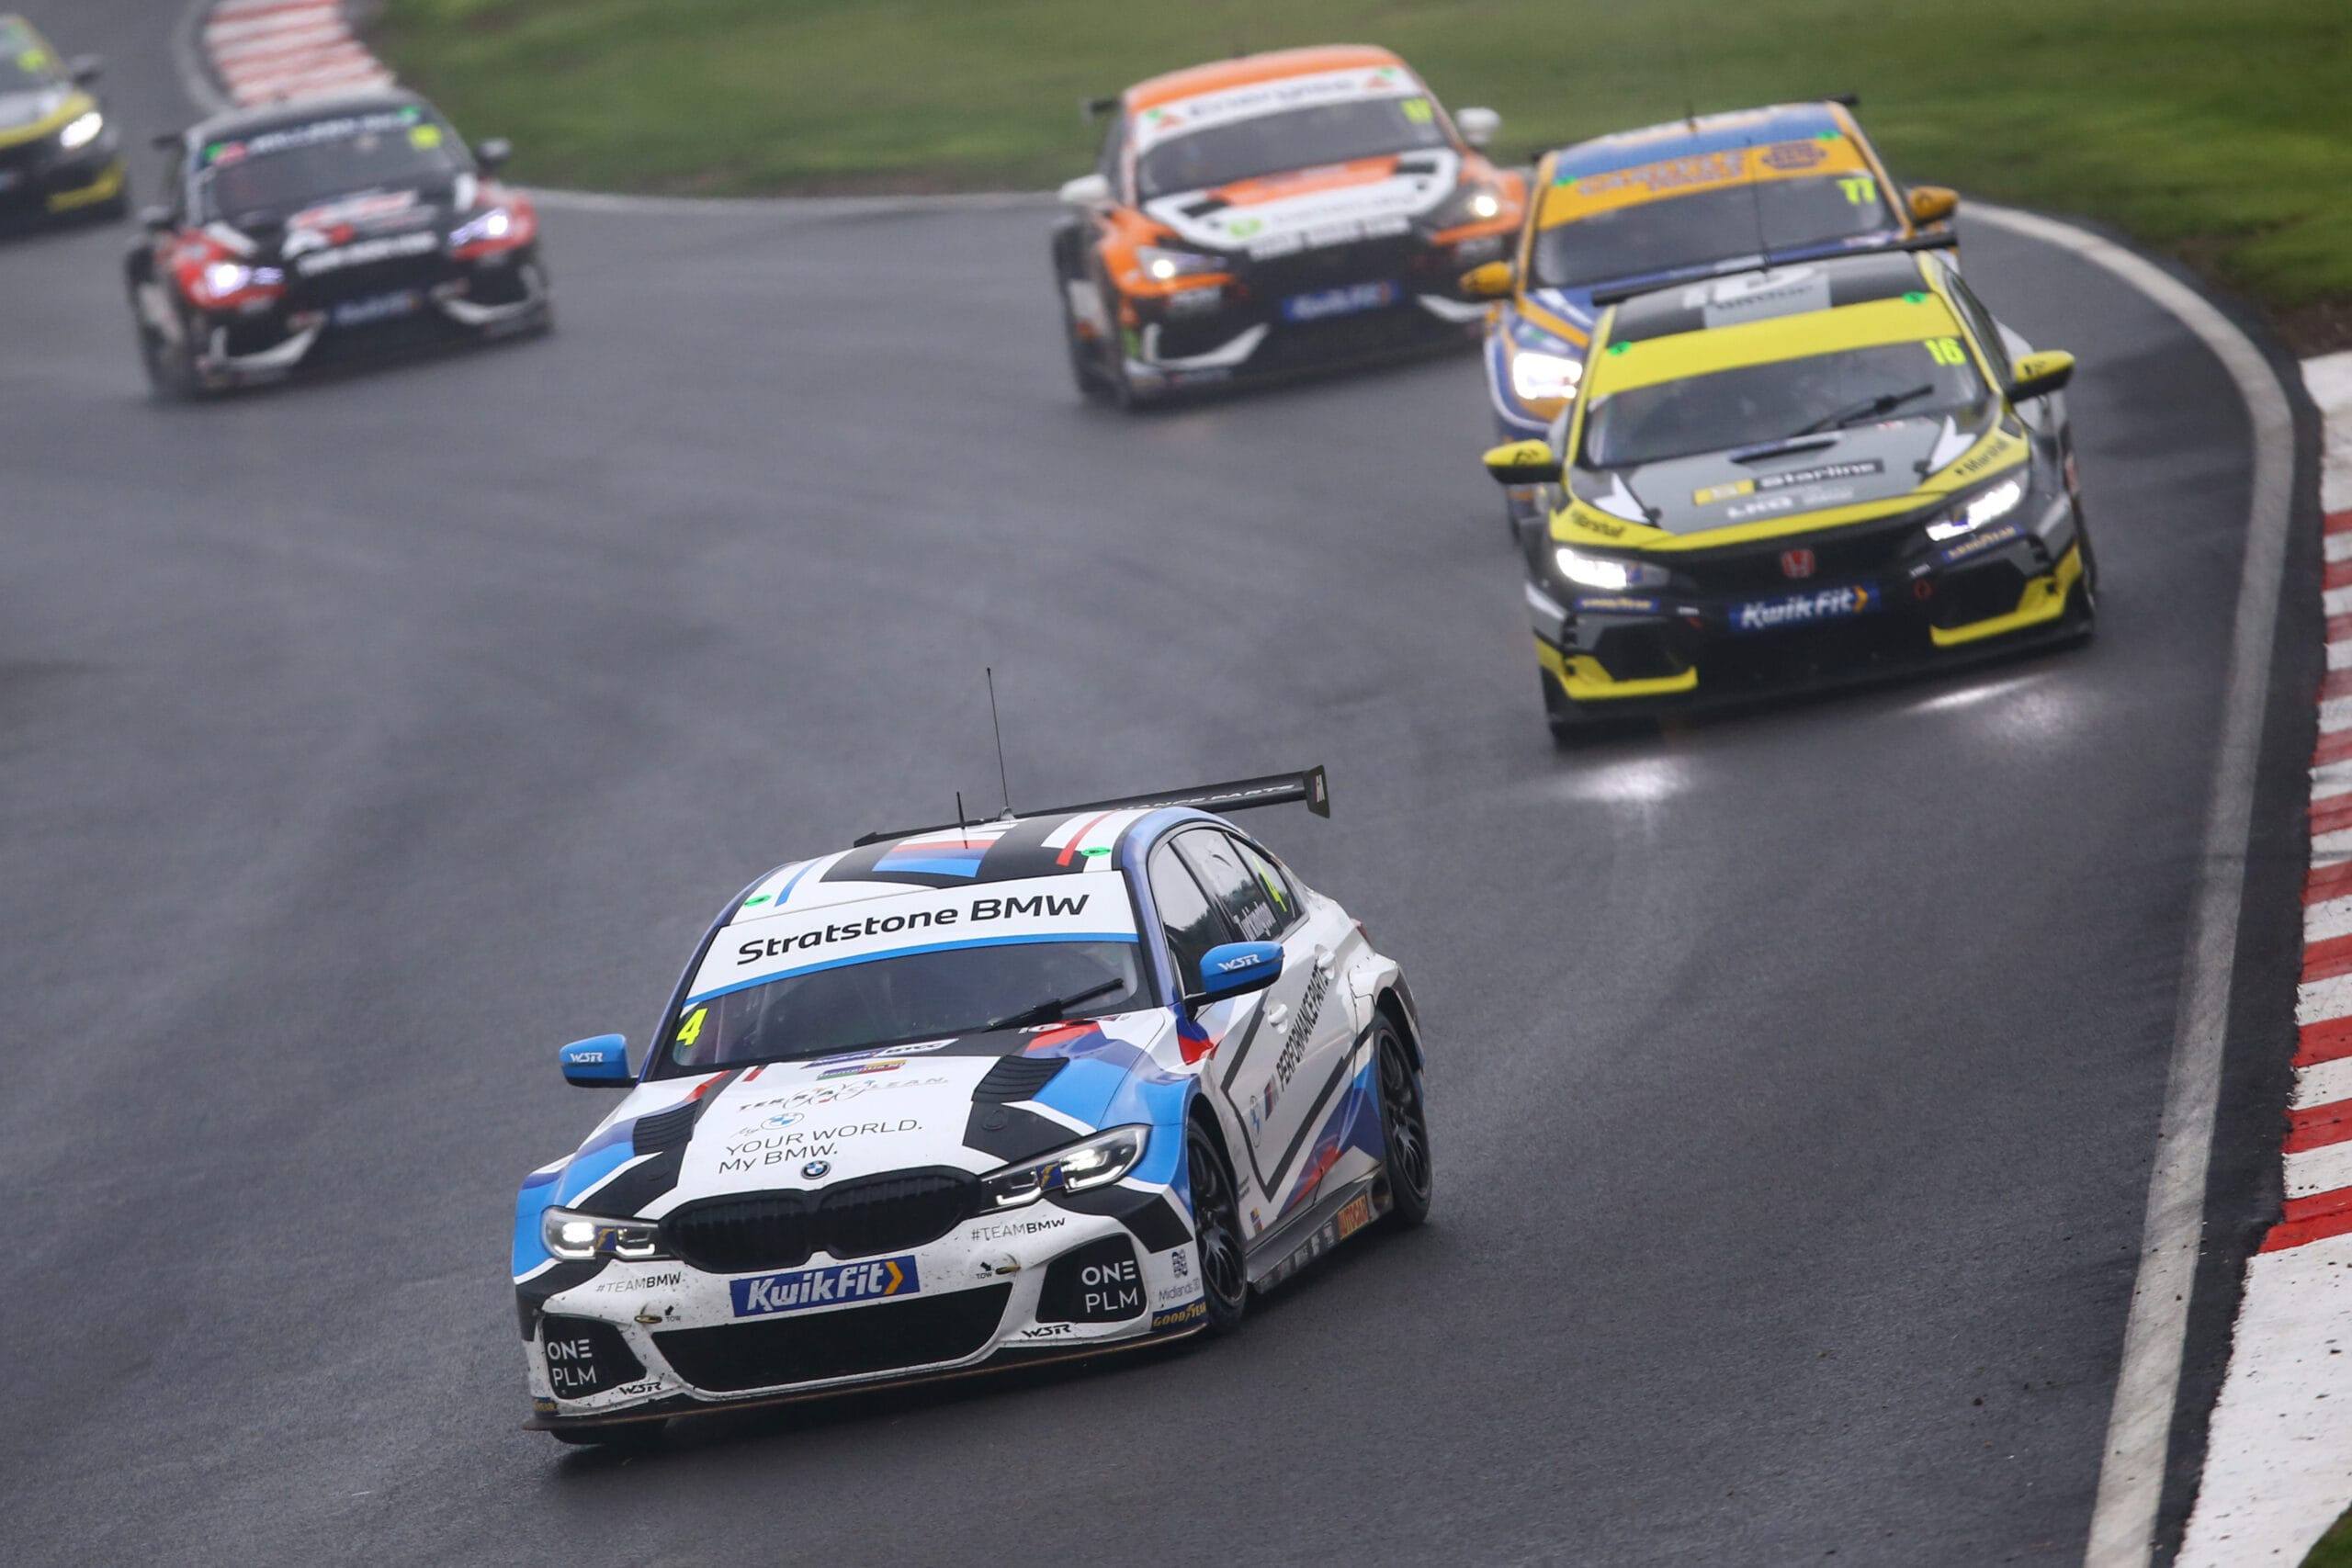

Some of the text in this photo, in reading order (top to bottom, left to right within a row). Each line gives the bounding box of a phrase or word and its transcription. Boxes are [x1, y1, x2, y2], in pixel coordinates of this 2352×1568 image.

[1925, 337, 1967, 366] 16
[737, 893, 1091, 966] Stratstone BMW
[1217, 953, 1261, 972] WSR
[676, 1007, 708, 1046] 4
[570, 1051, 604, 1064] WSR
[726, 1119, 923, 1157] YOUR WORLD.
[718, 1143, 839, 1175] My BMW.
[971, 1216, 1066, 1241] #TEAMBMW
[595, 1270, 683, 1293] #TEAMBMW
[976, 1271, 993, 1280] TOW
[1081, 1259, 1136, 1286] ONE
[1084, 1287, 1139, 1314] PLM
[665, 1314, 682, 1323] TOW
[1021, 1323, 1072, 1338] WSR
[547, 1338, 593, 1360] ONE
[551, 1364, 597, 1387] PLM
[618, 1381, 662, 1395] WSR
